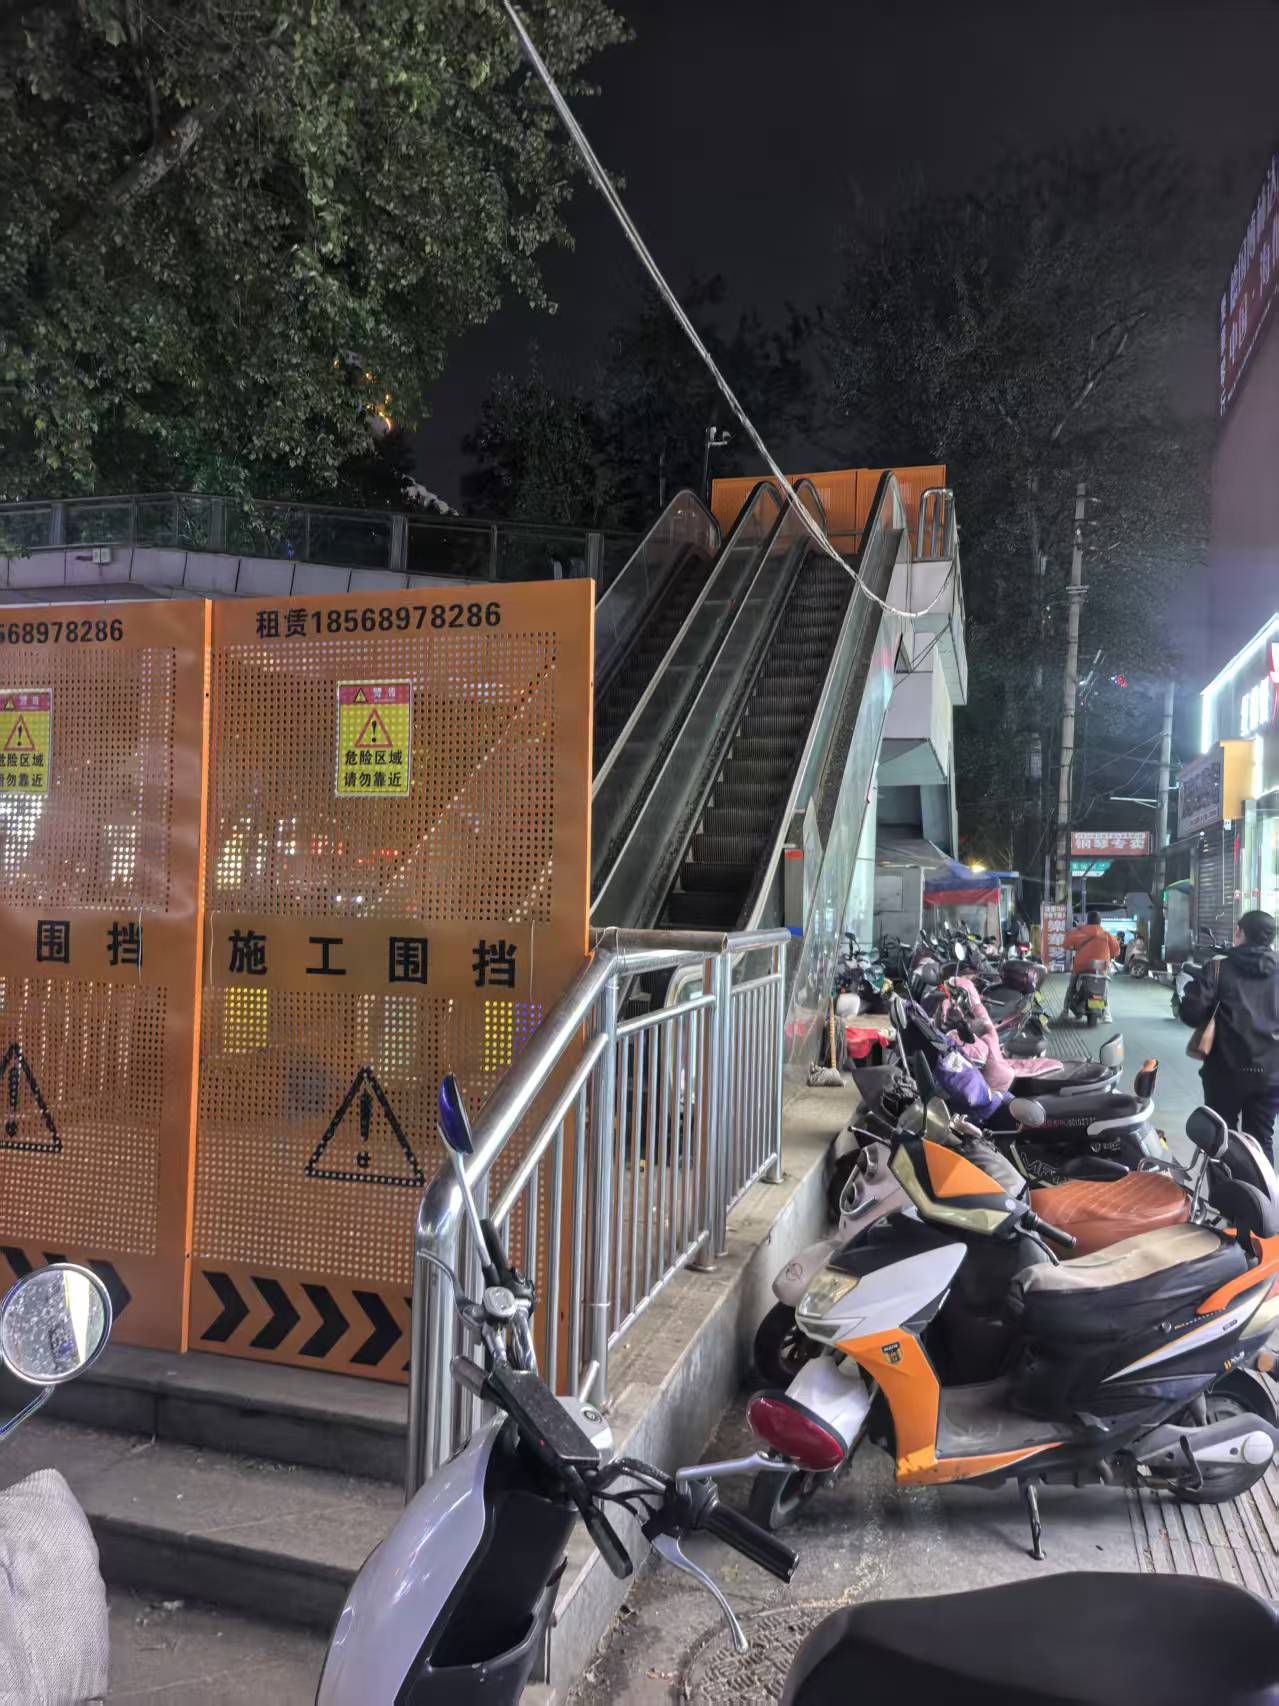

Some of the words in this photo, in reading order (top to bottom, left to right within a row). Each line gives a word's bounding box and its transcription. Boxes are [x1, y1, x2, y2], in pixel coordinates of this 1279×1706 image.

[256, 602, 501, 638] 租赁18568978286
[345, 750, 402, 765] 危险区域
[344, 771, 402, 787] 请勿靠近
[228, 929, 517, 988] 施工围挡
